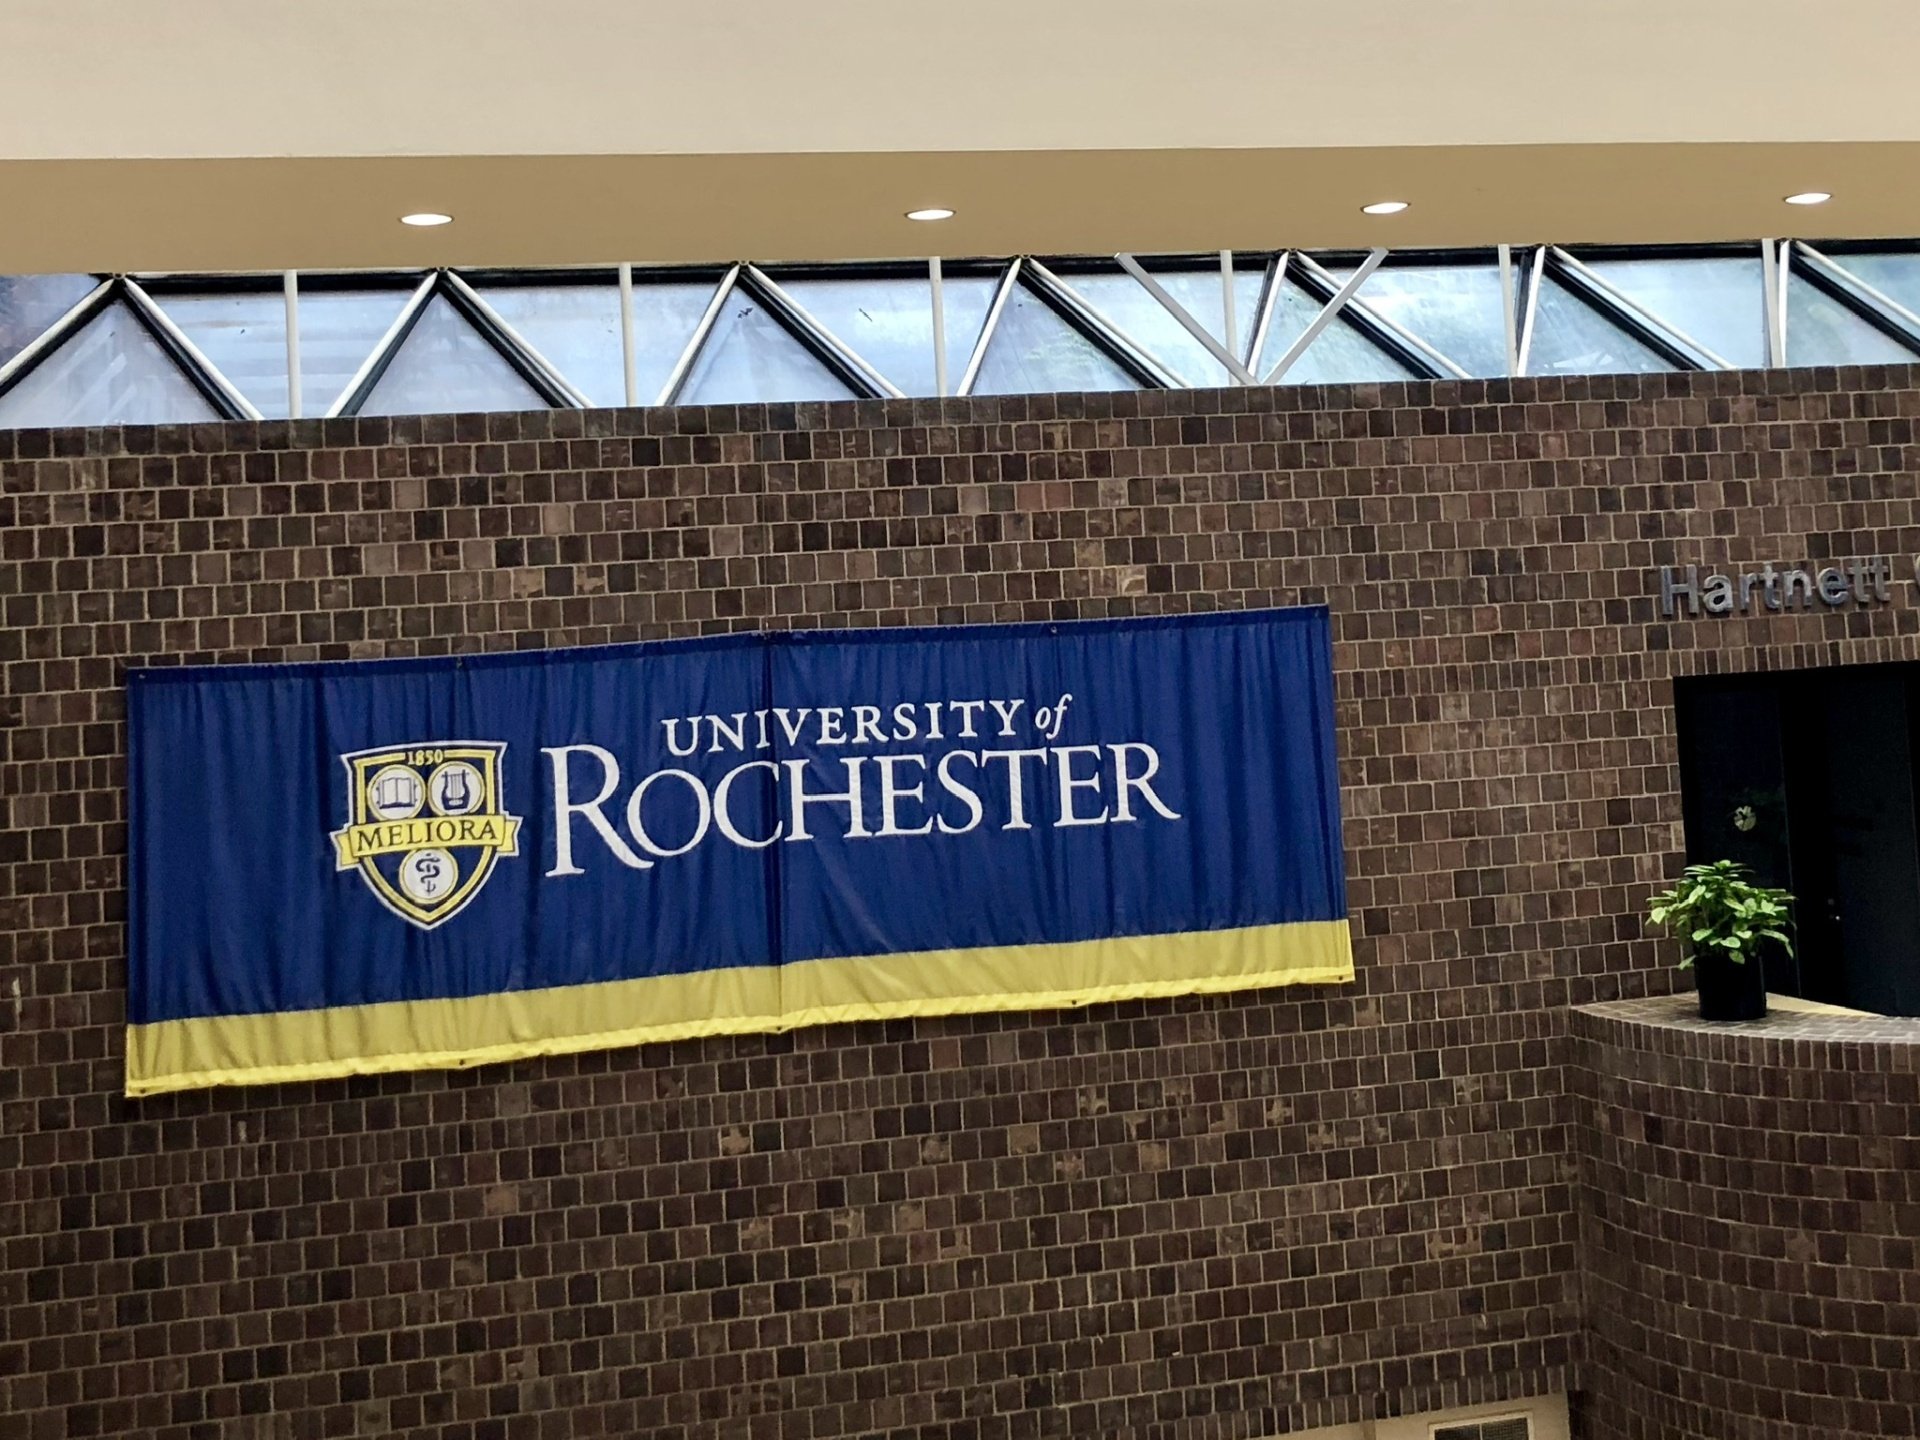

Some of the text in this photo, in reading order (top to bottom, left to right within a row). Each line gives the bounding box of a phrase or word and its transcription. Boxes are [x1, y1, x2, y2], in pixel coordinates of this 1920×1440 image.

[1660, 556, 1891, 616] Hartnett
[661, 693, 1073, 757] UNIVERSITY of
[405, 749, 445, 766] 1850
[356, 819, 498, 852] MELIORA
[540, 742, 1181, 878] ROCHESTER
